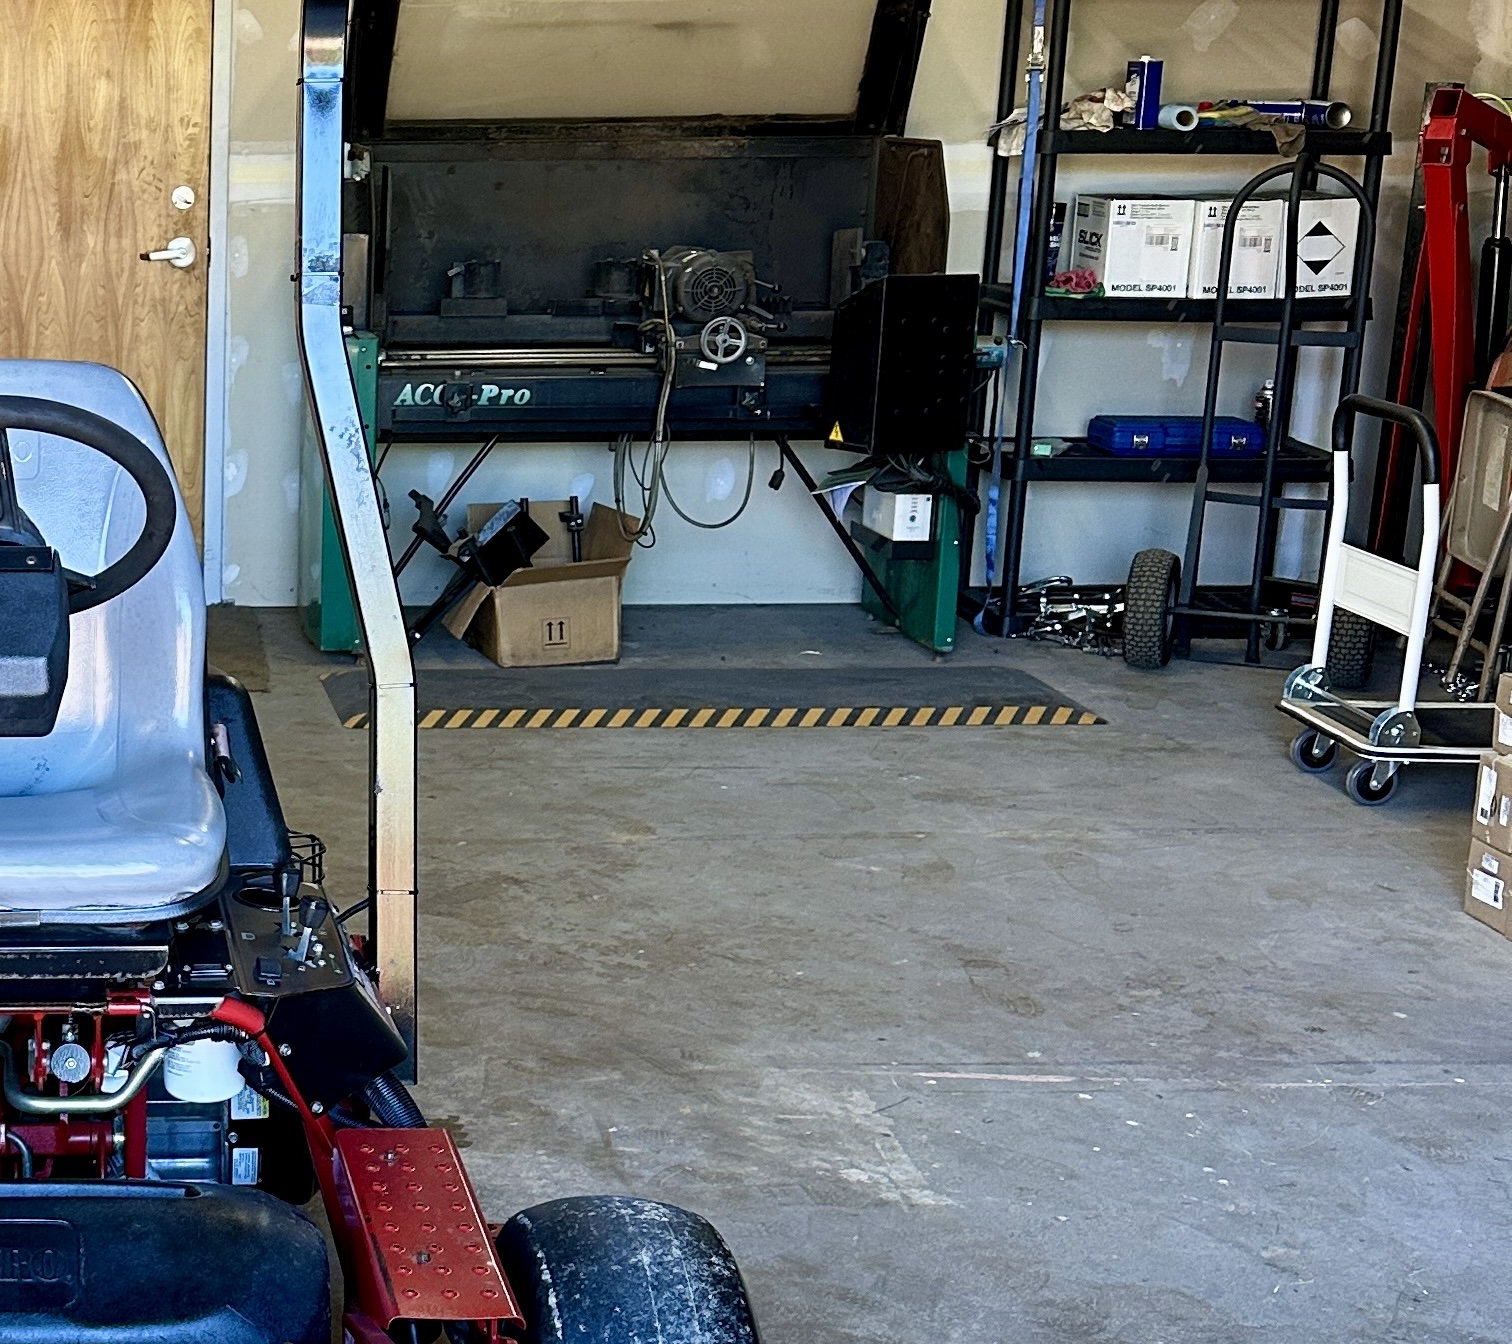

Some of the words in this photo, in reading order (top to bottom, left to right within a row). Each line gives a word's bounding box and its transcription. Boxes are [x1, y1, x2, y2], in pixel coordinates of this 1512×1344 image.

[1111, 284, 1143, 292] MODEL
[1145, 284, 1177, 292] SP4001
[393, 383, 531, 406] ACC-Pro
